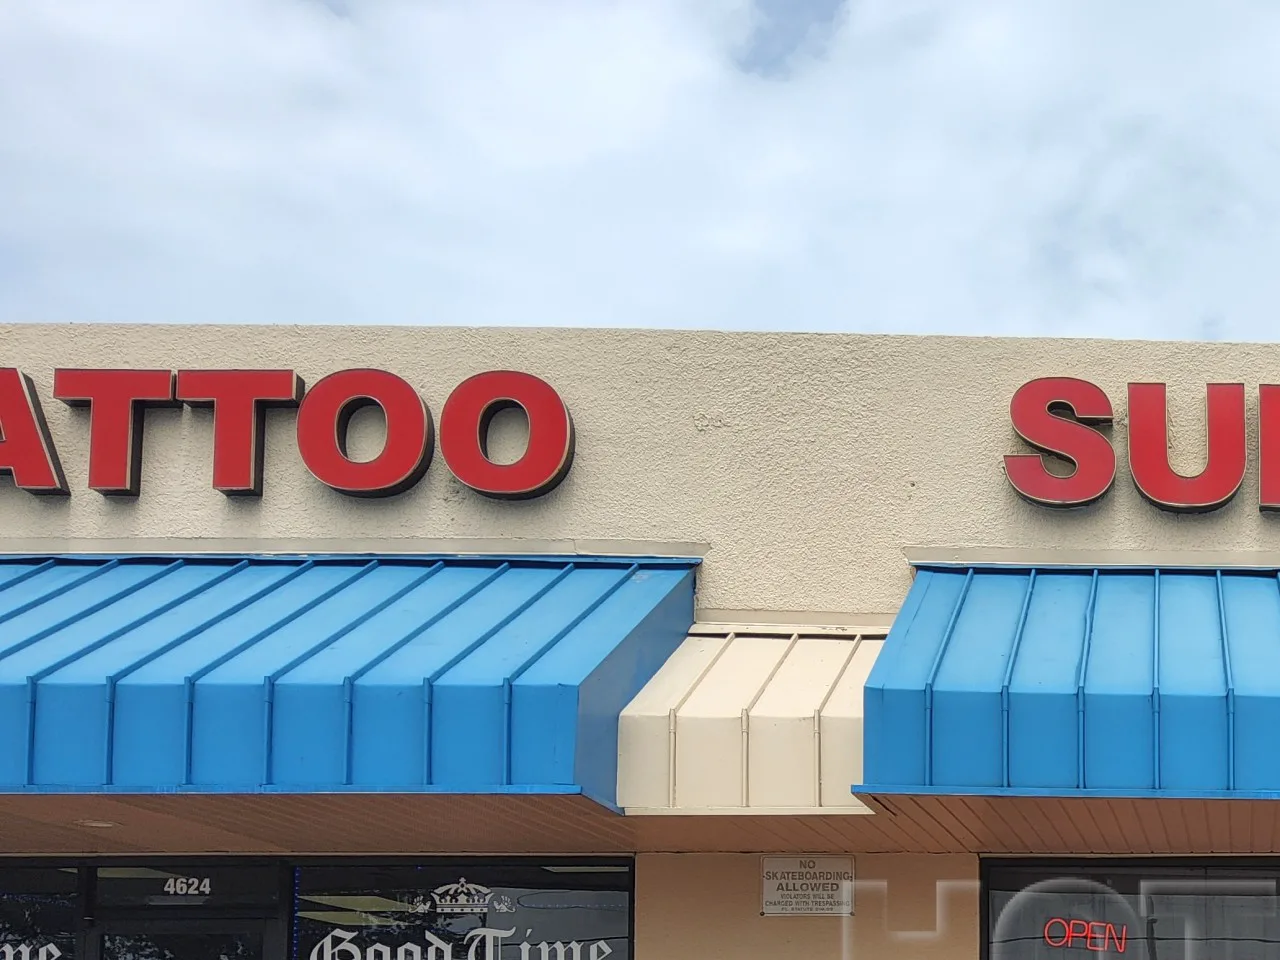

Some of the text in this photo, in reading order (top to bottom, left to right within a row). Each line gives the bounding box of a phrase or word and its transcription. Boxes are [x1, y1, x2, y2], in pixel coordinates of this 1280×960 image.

[799, 860, 816, 869] NO
[765, 871, 850, 881] SKATEBOARDING
[163, 877, 211, 895] 4624
[776, 882, 840, 892] ALLOWED
[1043, 917, 1127, 954] OPEN
